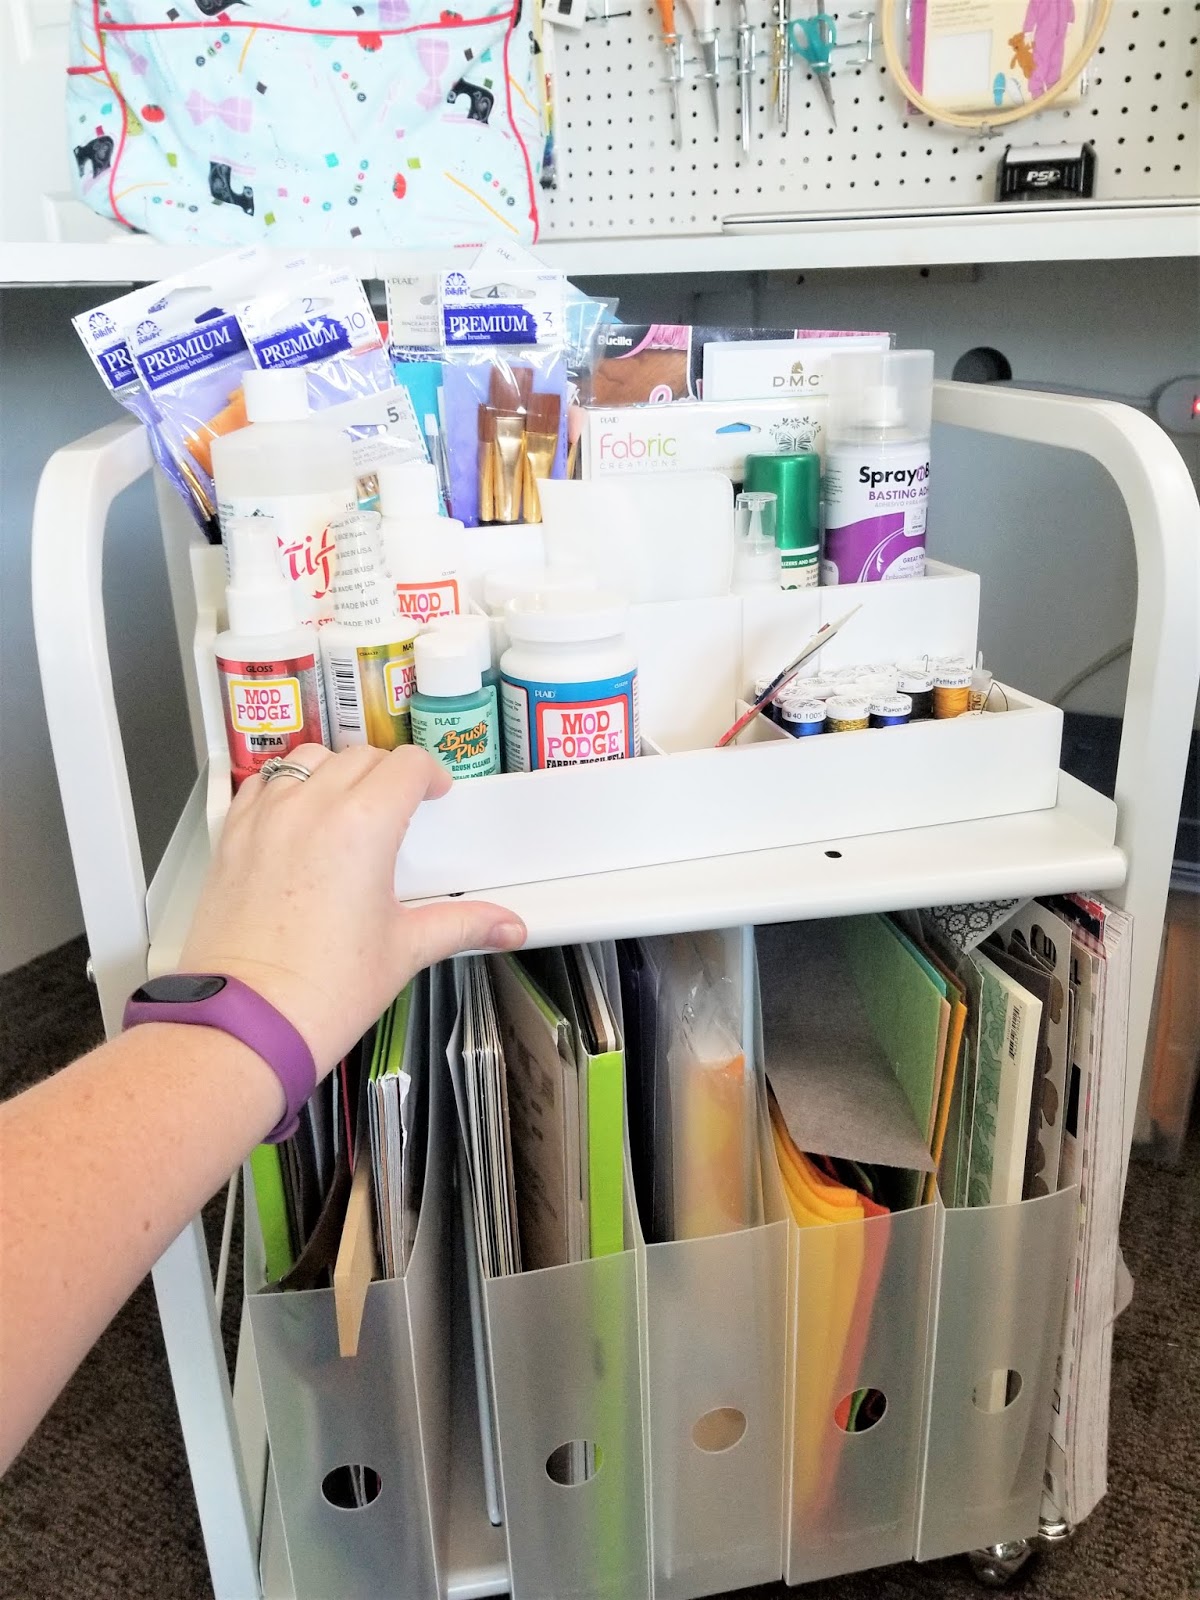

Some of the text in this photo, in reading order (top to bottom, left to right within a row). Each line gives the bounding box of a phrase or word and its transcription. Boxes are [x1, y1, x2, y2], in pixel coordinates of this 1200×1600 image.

[392, 277, 415, 285] PLAID
[487, 286, 500, 299] 4
[301, 297, 315, 314] 2
[344, 312, 366, 332] 10
[449, 315, 529, 333] PREMIUM
[260, 324, 340, 365] PREMIUM
[598, 335, 633, 346] Bucilla
[141, 325, 232, 375] PREMIUM
[151, 352, 215, 382] basecoating brushes
[387, 406, 399, 423] 5
[599, 460, 677, 470] CREATIONS
[869, 488, 916, 500] BASTING
[356, 547, 373, 555] USA
[903, 556, 917, 564] GREAT
[354, 582, 363, 590] IN
[364, 580, 376, 588] US
[359, 599, 369, 608] IN
[398, 593, 441, 612] MOD
[402, 642, 414, 652] MAT
[245, 665, 274, 673] GLOSS
[244, 689, 281, 705] MOD
[394, 681, 417, 702] POD
[534, 690, 555, 699] PLAID
[237, 704, 291, 721] PODGE
[883, 705, 903, 713] Rayon
[434, 717, 460, 726] PLAID
[792, 712, 802, 720] 40
[805, 711, 822, 720] 100%
[560, 710, 610, 735] MOD
[250, 737, 283, 746] ULTRA
[438, 720, 488, 751] Brush
[547, 731, 619, 758] PODGE
[455, 740, 486, 764] Plus
[451, 763, 471, 772] BRUSH
